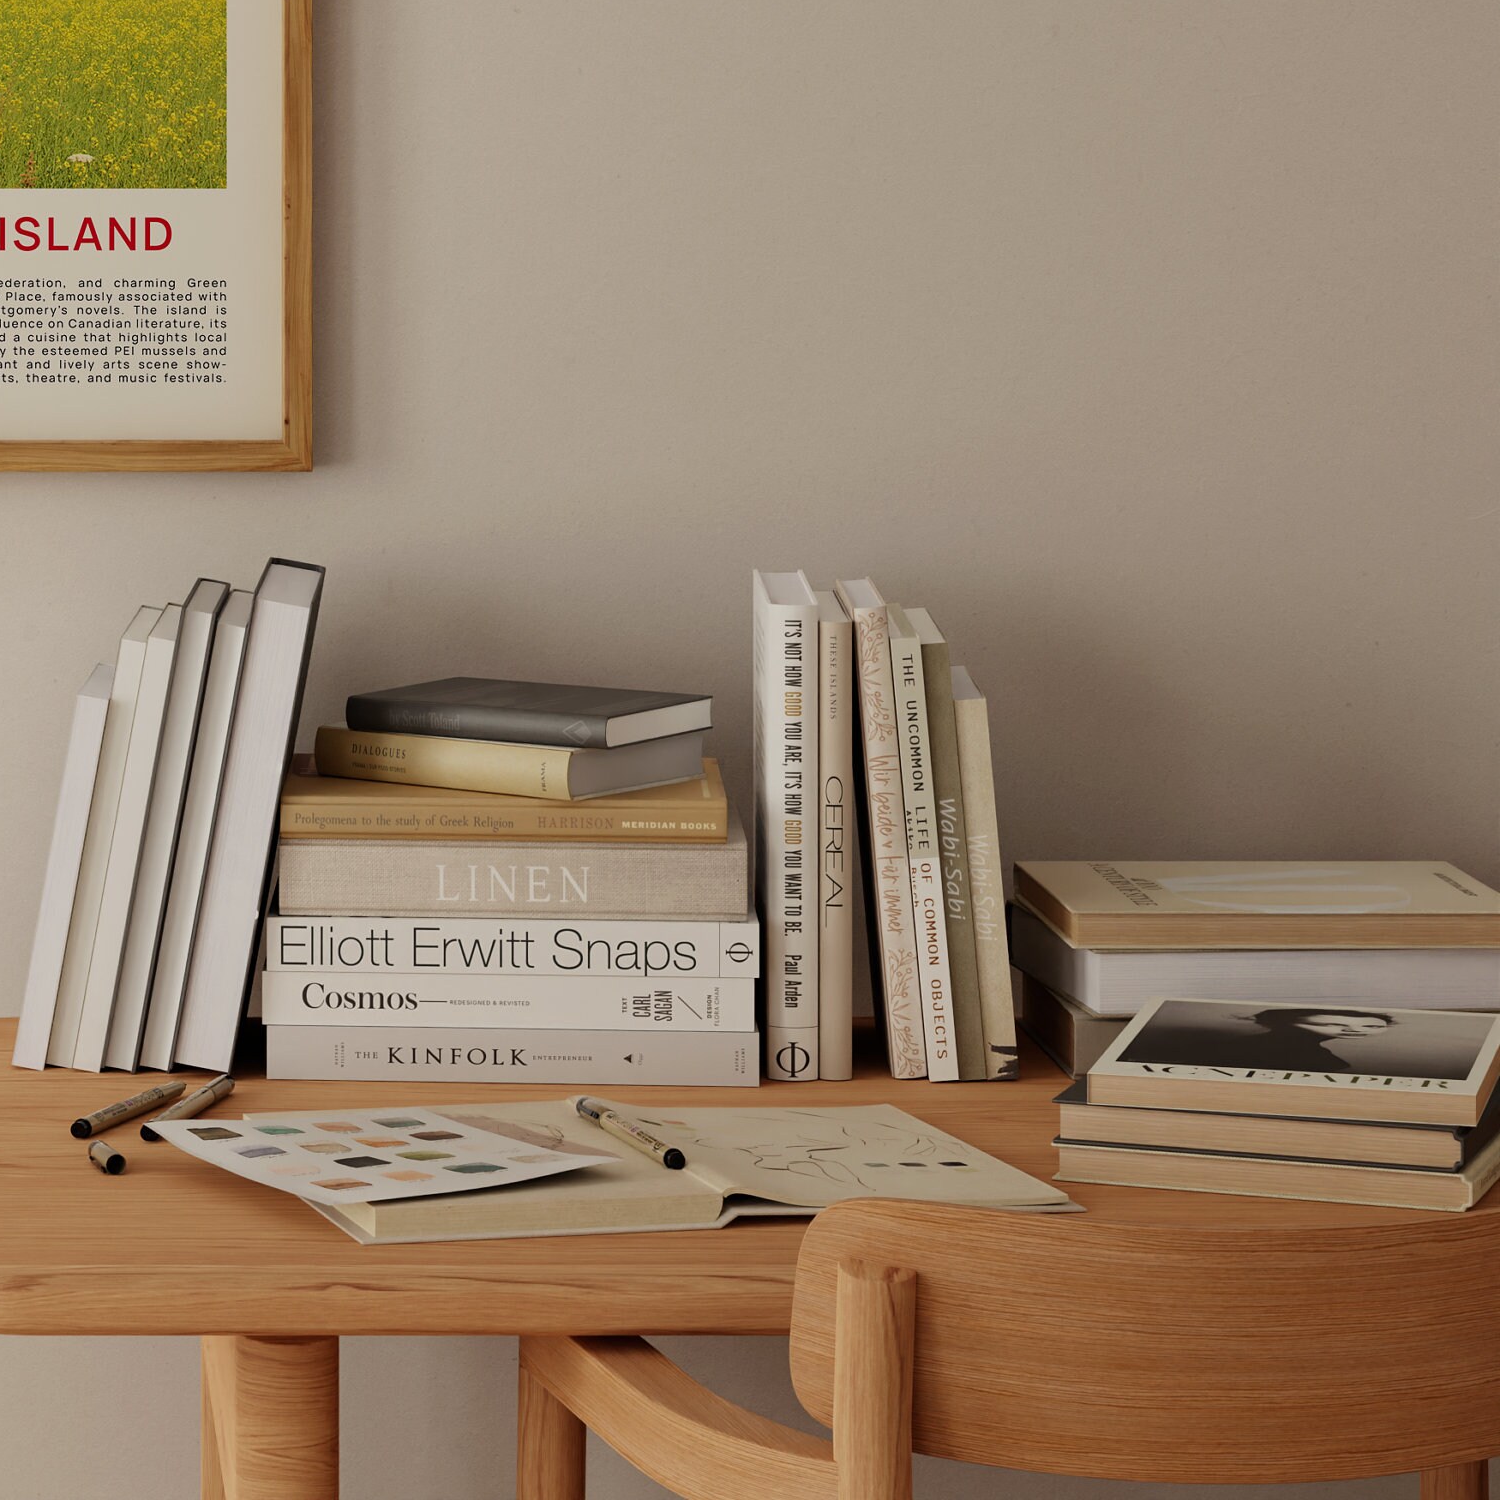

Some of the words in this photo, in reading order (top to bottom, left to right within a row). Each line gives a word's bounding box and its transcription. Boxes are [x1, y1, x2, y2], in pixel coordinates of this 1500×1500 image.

[0, 216, 173, 252] ISLAND
[78, 278, 102, 288] and
[113, 277, 176, 291] charming
[186, 277, 227, 289] Green
[5, 291, 46, 303] Place,
[51, 291, 113, 305] famously
[118, 291, 193, 302] associated
[198, 291, 227, 302] with
[76, 305, 125, 316] novels.
[133, 304, 158, 316] The
[166, 304, 207, 316] island
[216, 304, 228, 316] is
[47, 320, 64, 329] on
[67, 318, 132, 329] Canadian
[136, 318, 205, 330] literature,
[209, 318, 227, 329] its
[13, 334, 21, 343] a
[27, 332, 77, 343] cuisine
[83, 332, 112, 343] that
[118, 332, 188, 346] highlights
[194, 332, 227, 343] local
[784, 620, 802, 638] IT'S
[784, 642, 802, 661] NOT
[829, 636, 837, 669] THESE
[784, 665, 802, 688] HOW
[902, 653, 915, 688] THE
[784, 691, 802, 717] GOOD
[829, 674, 837, 720] ISLANDS
[784, 721, 802, 740] YOU
[352, 743, 407, 760] DIALOGUES
[782, 745, 802, 767] ARE,
[907, 700, 924, 792] UNCOMMON
[784, 771, 802, 790] IT'S
[869, 754, 898, 787] Wir
[784, 793, 802, 816] HOW
[871, 792, 900, 837] beide
[295, 812, 357, 830] Prolegomena
[362, 815, 372, 827] to
[376, 814, 392, 827] the
[395, 814, 421, 831] study
[425, 814, 436, 827] of
[440, 814, 469, 828] Greek
[473, 816, 514, 832] Religion
[538, 816, 614, 830] HARRISON
[621, 820, 676, 830] MERIDIAN
[681, 821, 717, 831] BOOKS
[784, 820, 802, 845] GOOD
[915, 806, 930, 850] LIFE
[784, 850, 802, 868] YOU
[825, 776, 844, 928] CEREAL
[938, 798, 966, 921] Wabi-Sabi
[436, 864, 591, 904] LINEN
[920, 863, 932, 884] OF
[784, 873, 802, 900] WANT
[967, 835, 998, 942] Wabi-Sabi
[784, 904, 802, 917] TO
[883, 888, 905, 937] immer
[784, 921, 802, 937] BE.
[924, 898, 940, 965] COMMON
[280, 925, 395, 967] Elliott
[413, 926, 535, 970] Erwitt
[552, 928, 698, 977] Snaps
[784, 954, 802, 975] Paul
[301, 982, 418, 1011] Cosmos
[449, 999, 491, 1007] REDESIGNED
[784, 979, 802, 1008] Arden
[632, 994, 651, 1018] CARL
[654, 990, 673, 1022] SAGAN
[931, 979, 948, 1060] OBJECTS
[355, 1051, 379, 1059] THE
[387, 1047, 528, 1067] KINFOLK
